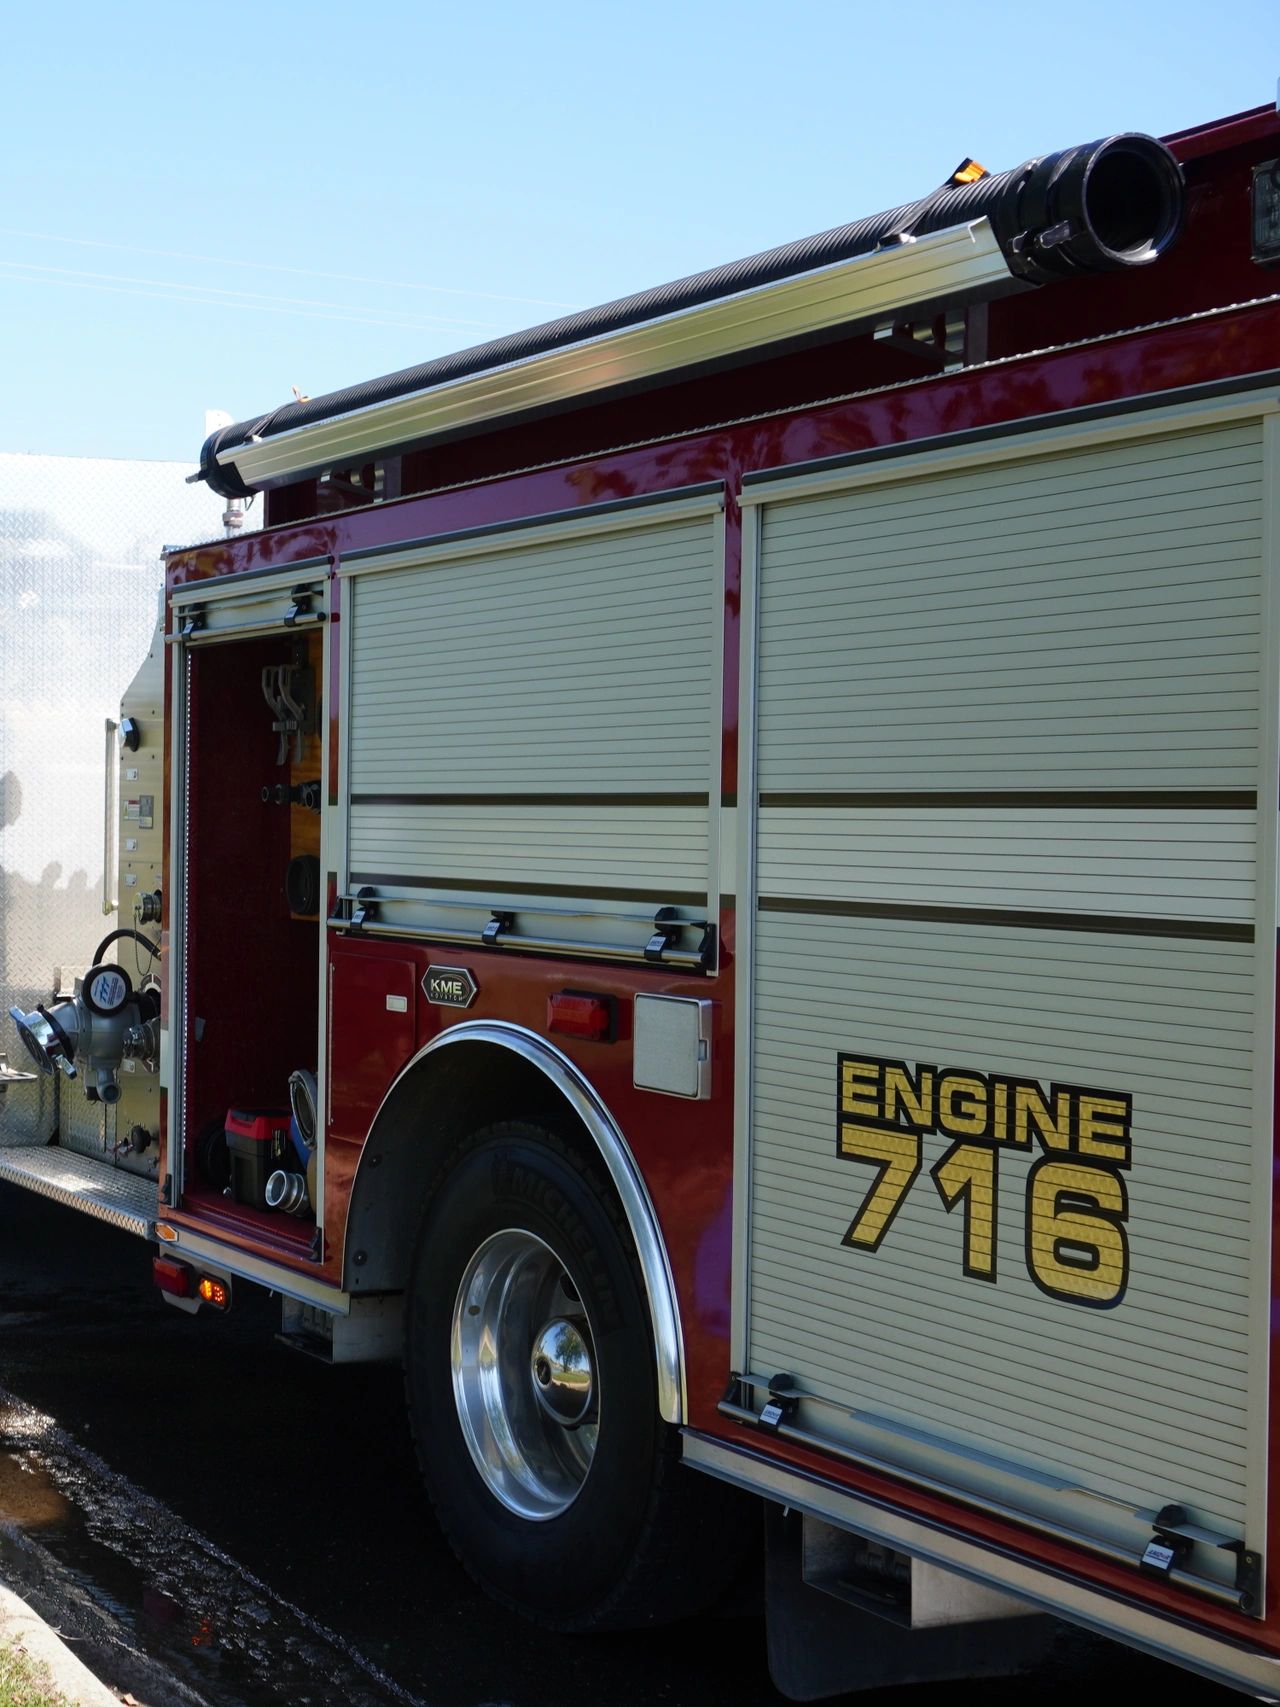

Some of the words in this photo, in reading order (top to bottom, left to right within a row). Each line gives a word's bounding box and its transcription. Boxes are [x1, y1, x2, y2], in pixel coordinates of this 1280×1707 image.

[430, 978, 462, 995] KME
[837, 1053, 1132, 1168] ENGINE
[512, 1168, 622, 1322] MICHELIN
[837, 1121, 1130, 1310] 716
